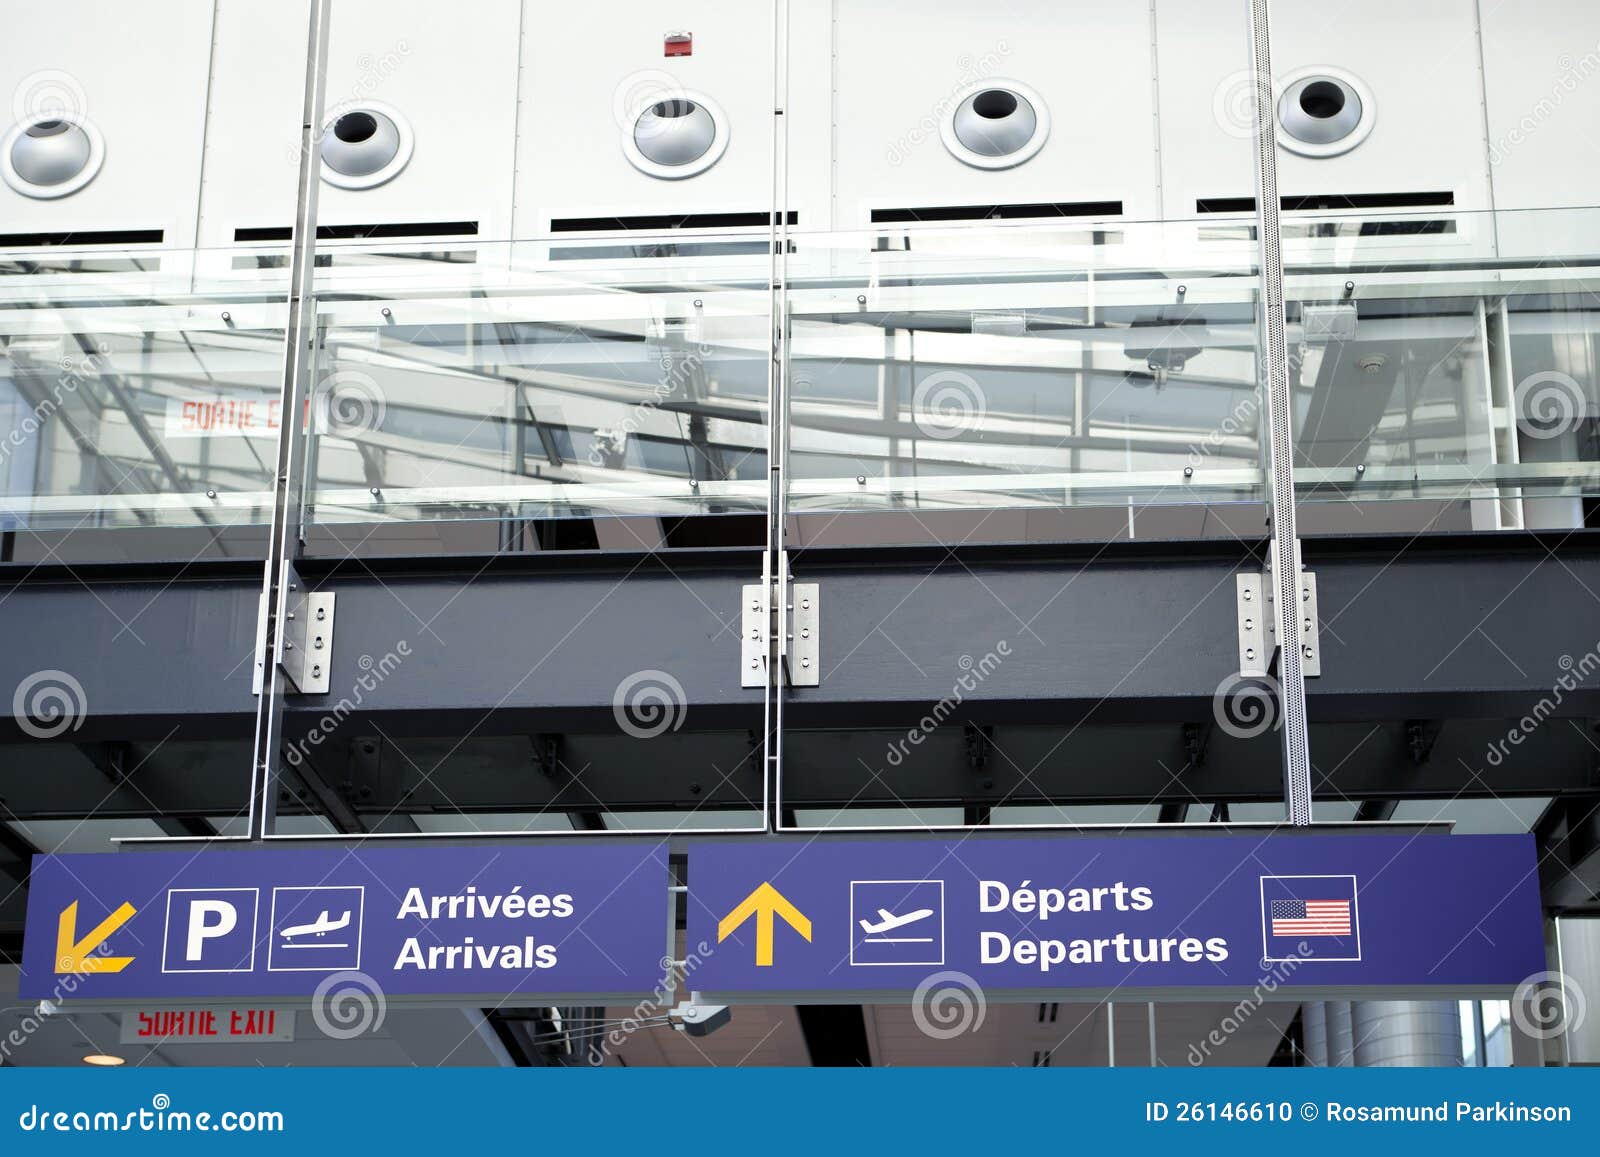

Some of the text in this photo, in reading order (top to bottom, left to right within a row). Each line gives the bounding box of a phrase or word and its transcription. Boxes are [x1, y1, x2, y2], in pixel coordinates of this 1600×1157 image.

[396, 885, 574, 919] Arrivées
[979, 880, 1154, 920] Départs
[186, 900, 237, 961] P
[394, 936, 558, 970] Arrivals
[980, 932, 1229, 972] Departures
[138, 1009, 275, 1037] SORTIE EXIT
